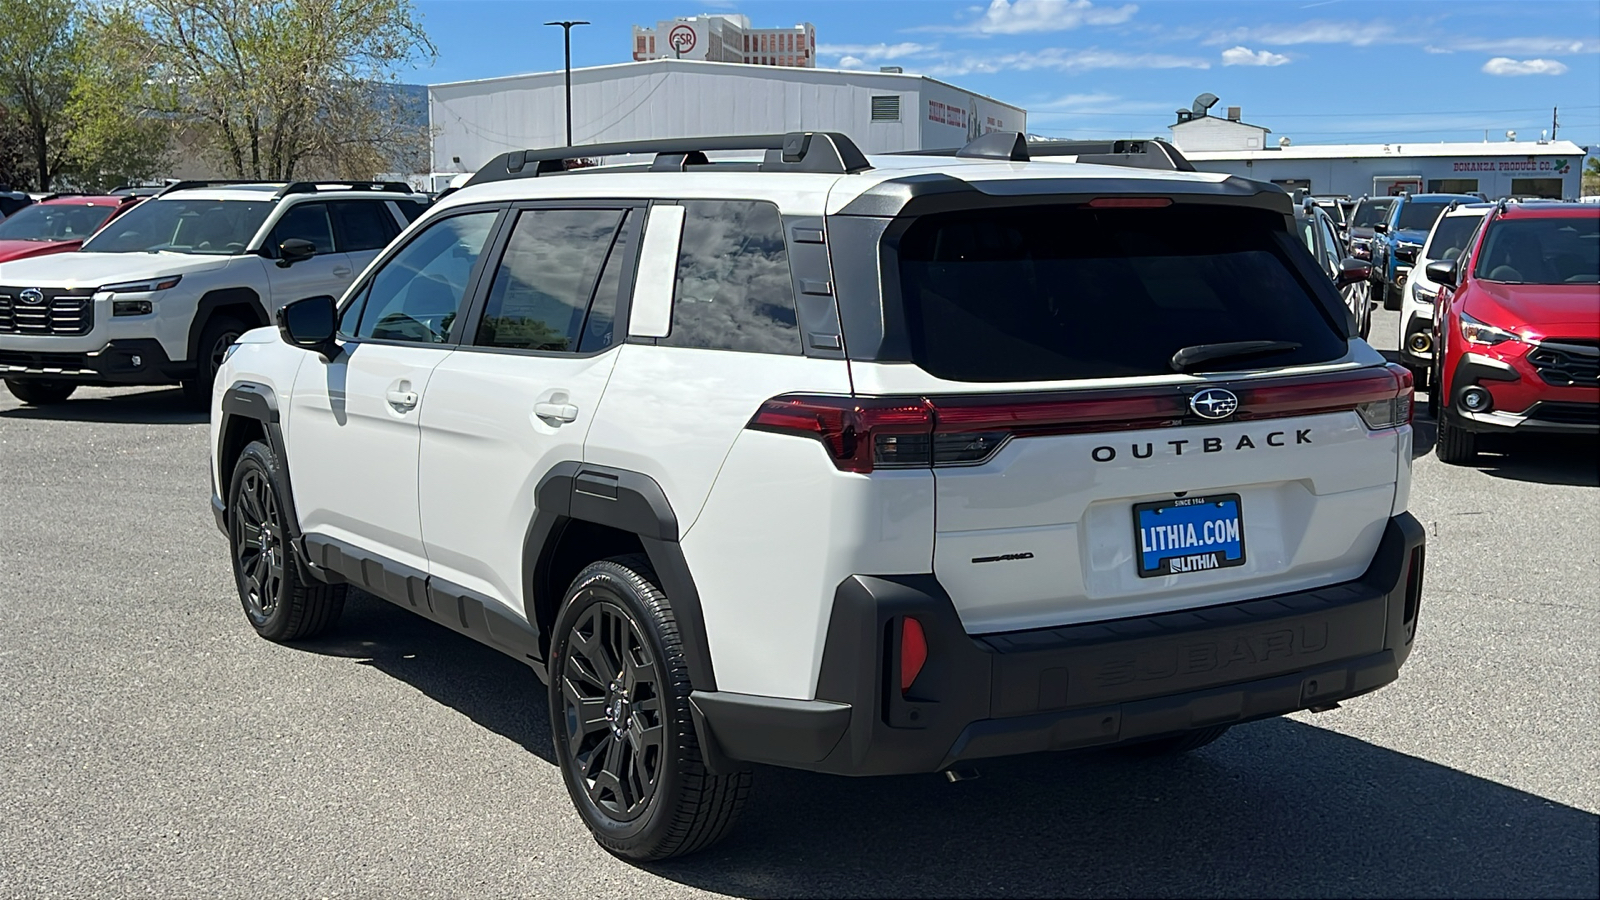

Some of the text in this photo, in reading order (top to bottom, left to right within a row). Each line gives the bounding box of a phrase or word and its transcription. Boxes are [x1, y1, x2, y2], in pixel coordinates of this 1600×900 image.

[1453, 161, 1553, 172] BONANZA PRODUCE CO.
[1091, 428, 1313, 463] OUTBACK
[1174, 499, 1191, 507] SINCE
[1141, 518, 1240, 553] LITHIA.COM
[1181, 553, 1219, 572] LITHIA
[1096, 621, 1328, 688] SUBARU
